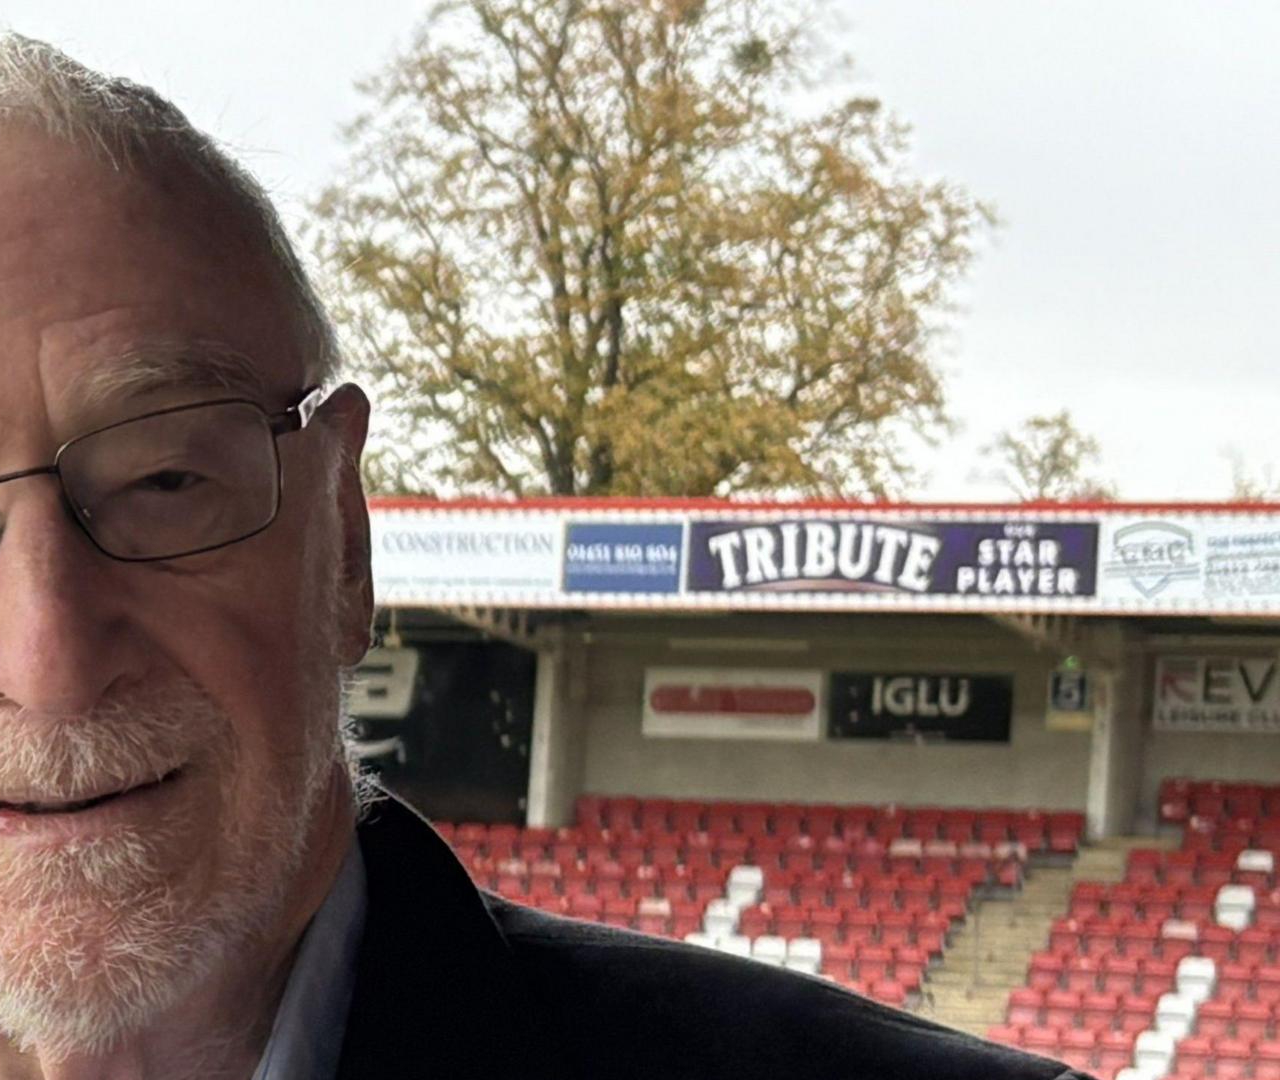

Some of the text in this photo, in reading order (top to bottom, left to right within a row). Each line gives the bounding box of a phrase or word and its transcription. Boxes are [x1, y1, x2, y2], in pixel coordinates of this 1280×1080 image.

[382, 531, 554, 556] CONSTRUCTION
[709, 522, 941, 593] TRIBUTE
[978, 539, 1061, 566] STAR
[957, 566, 1080, 594] PLAYER
[872, 677, 970, 717] IGLU
